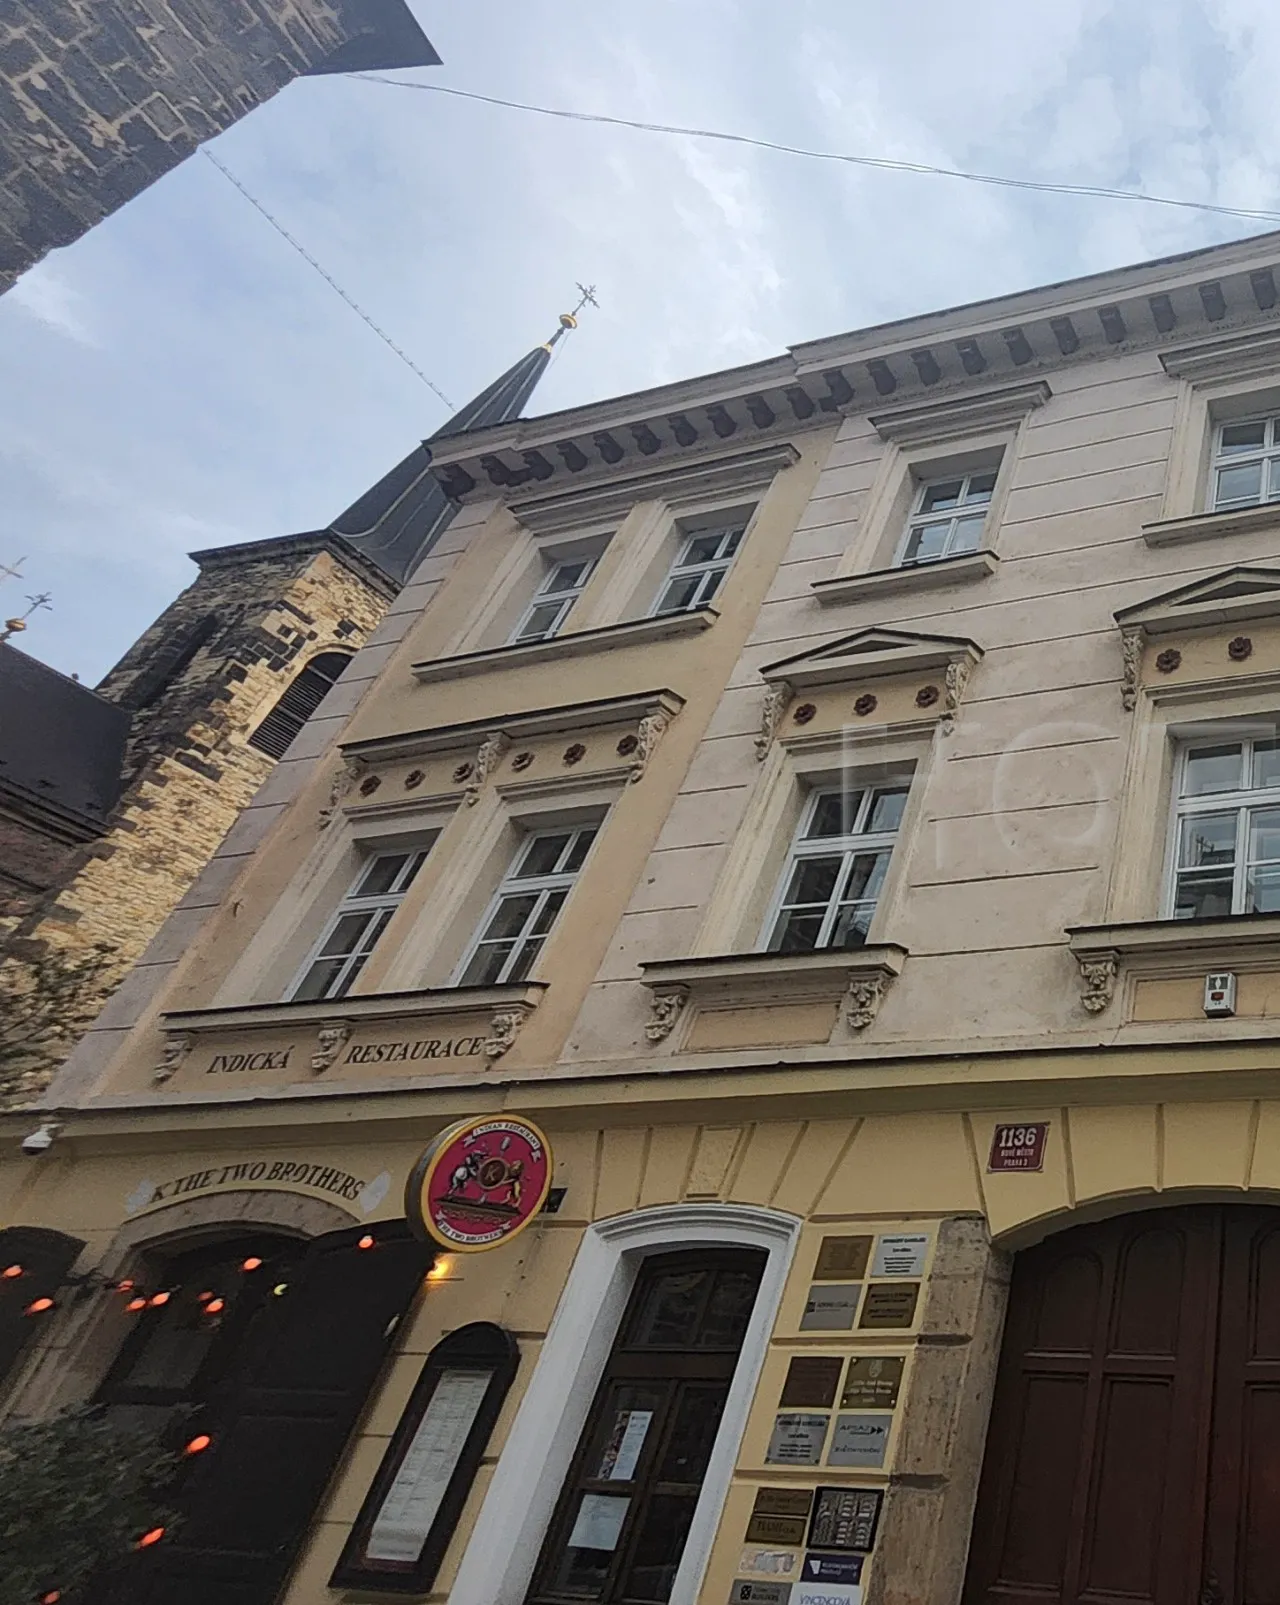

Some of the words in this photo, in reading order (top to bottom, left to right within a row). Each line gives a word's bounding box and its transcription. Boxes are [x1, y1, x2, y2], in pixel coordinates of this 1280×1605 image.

[206, 1045, 295, 1074] INDICKÁ
[343, 1037, 487, 1064] RESTAURACE
[999, 1127, 1037, 1147] 1136
[172, 1169, 218, 1196] THE
[217, 1162, 267, 1185] TWO
[266, 1161, 366, 1201] BROTHERS
